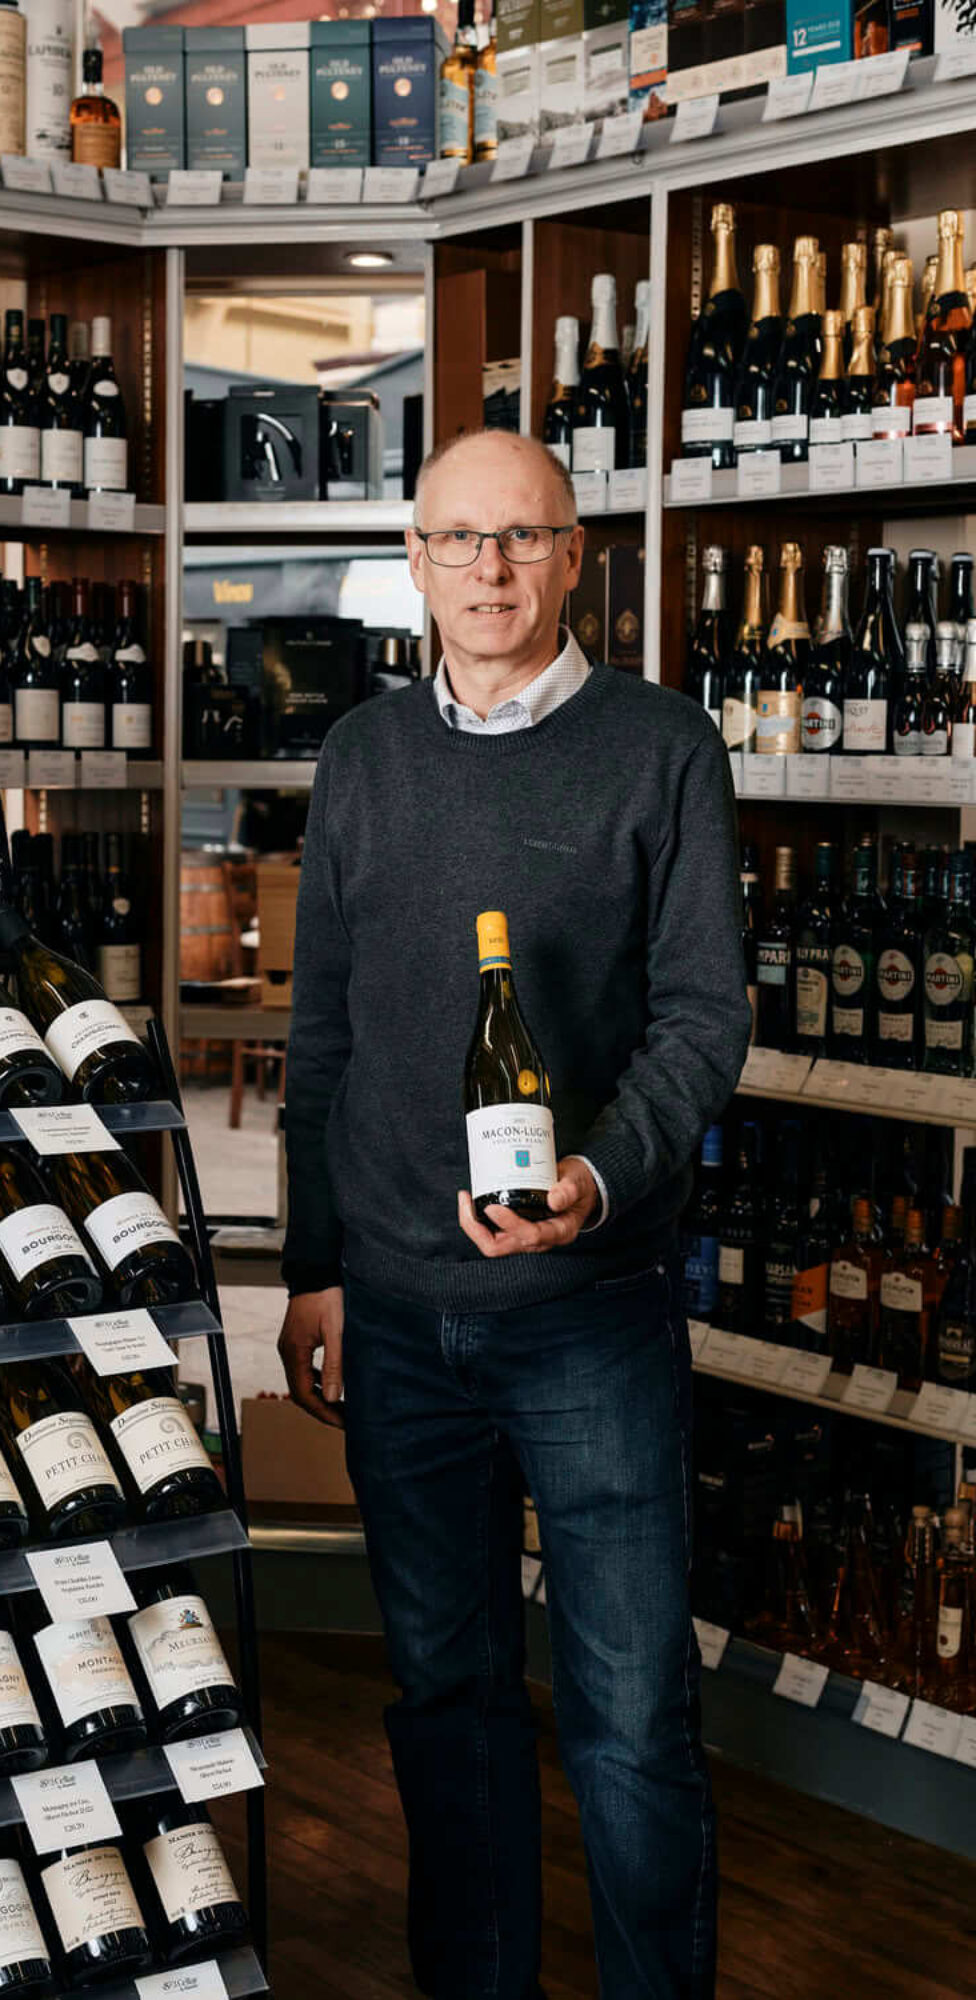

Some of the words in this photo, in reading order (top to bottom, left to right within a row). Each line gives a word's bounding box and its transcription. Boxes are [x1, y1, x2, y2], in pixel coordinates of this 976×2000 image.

[793, 29, 807, 46] 12
[803, 717, 836, 730] ARTINI
[139, 1441, 173, 1464] PETIT
[44, 1455, 79, 1479] PETIT
